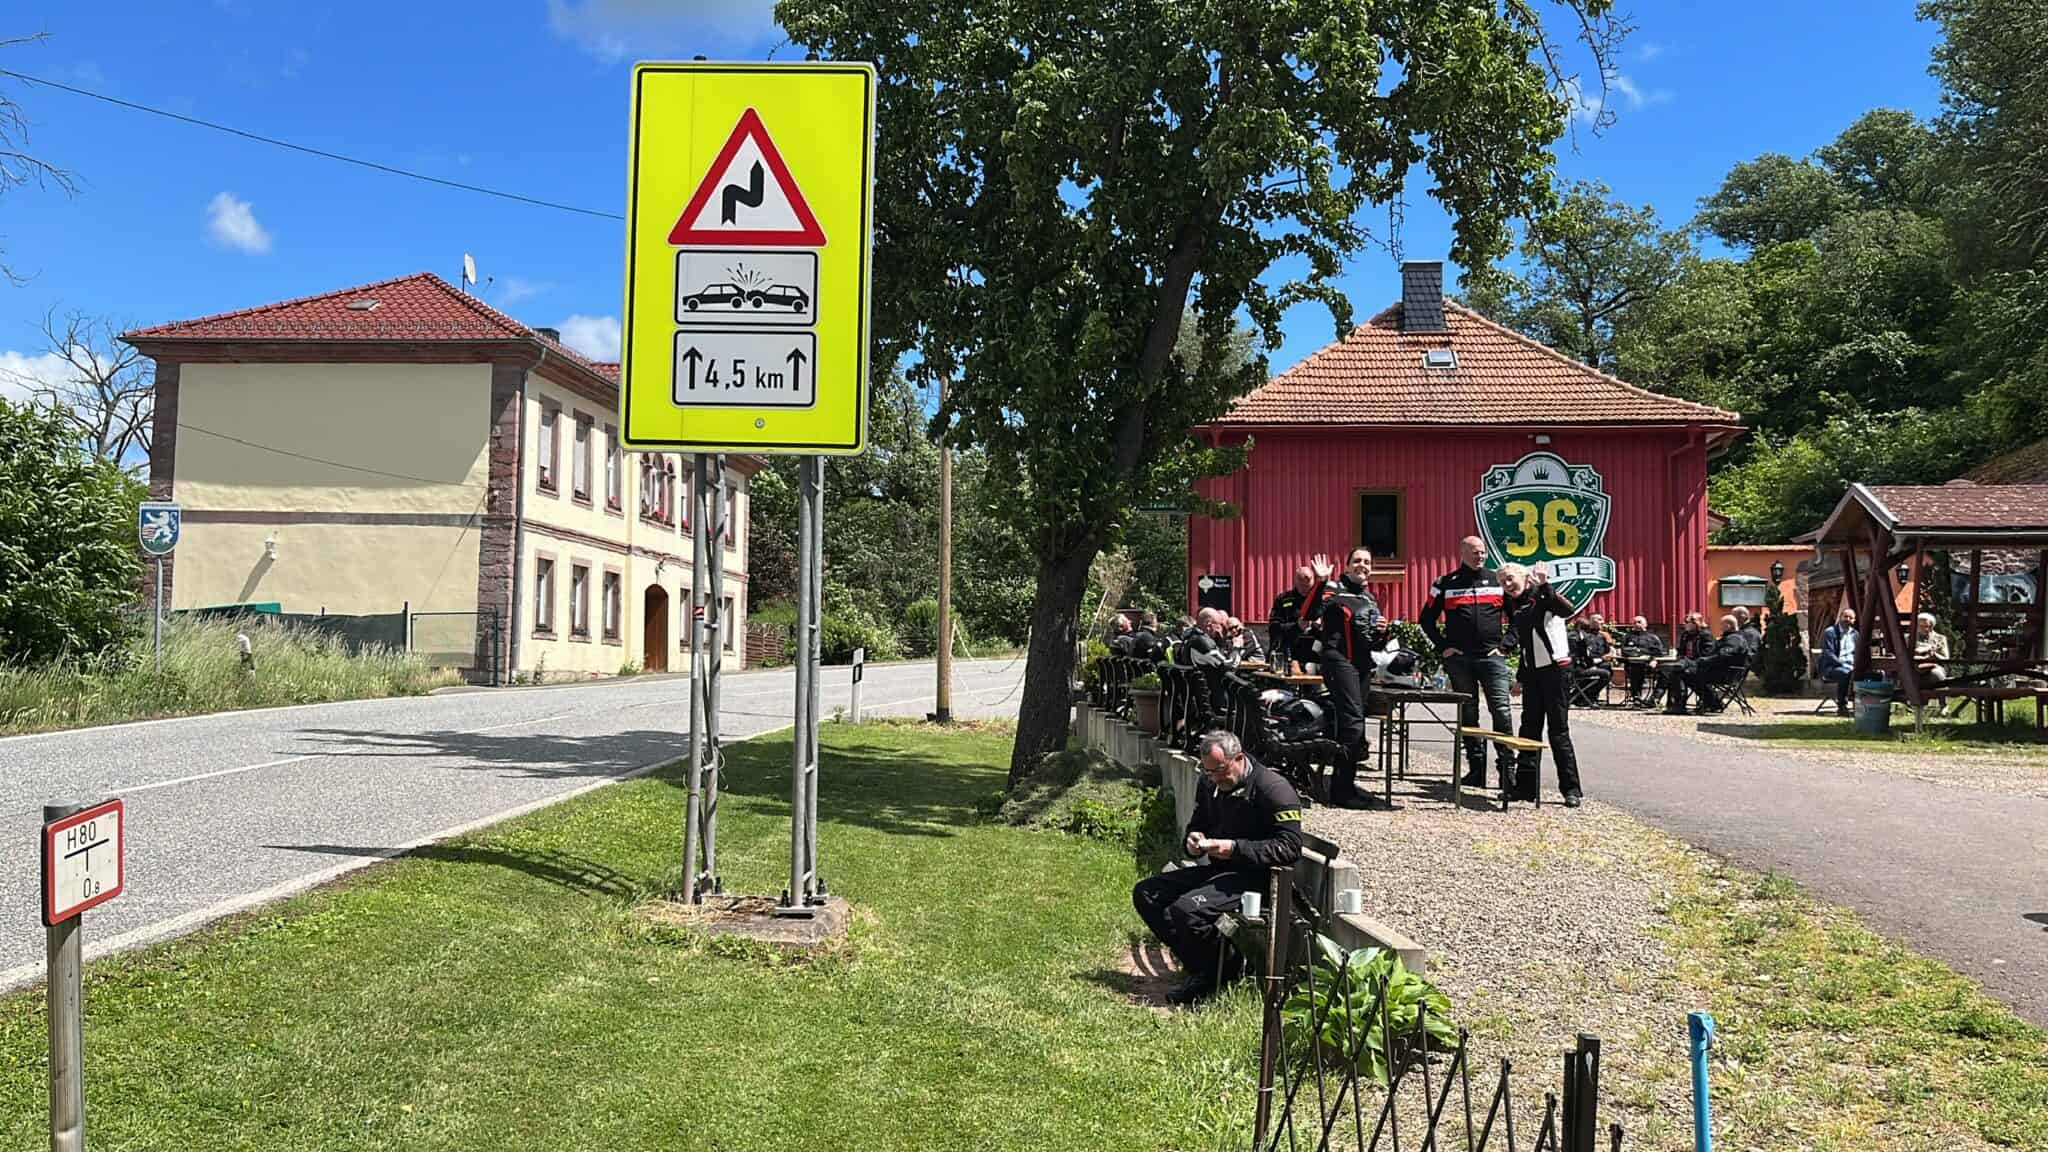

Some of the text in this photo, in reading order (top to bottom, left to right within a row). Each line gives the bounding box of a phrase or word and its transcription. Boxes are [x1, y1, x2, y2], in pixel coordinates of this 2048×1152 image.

[704, 358, 784, 391] 4,5 km
[1505, 498, 1579, 557] 36
